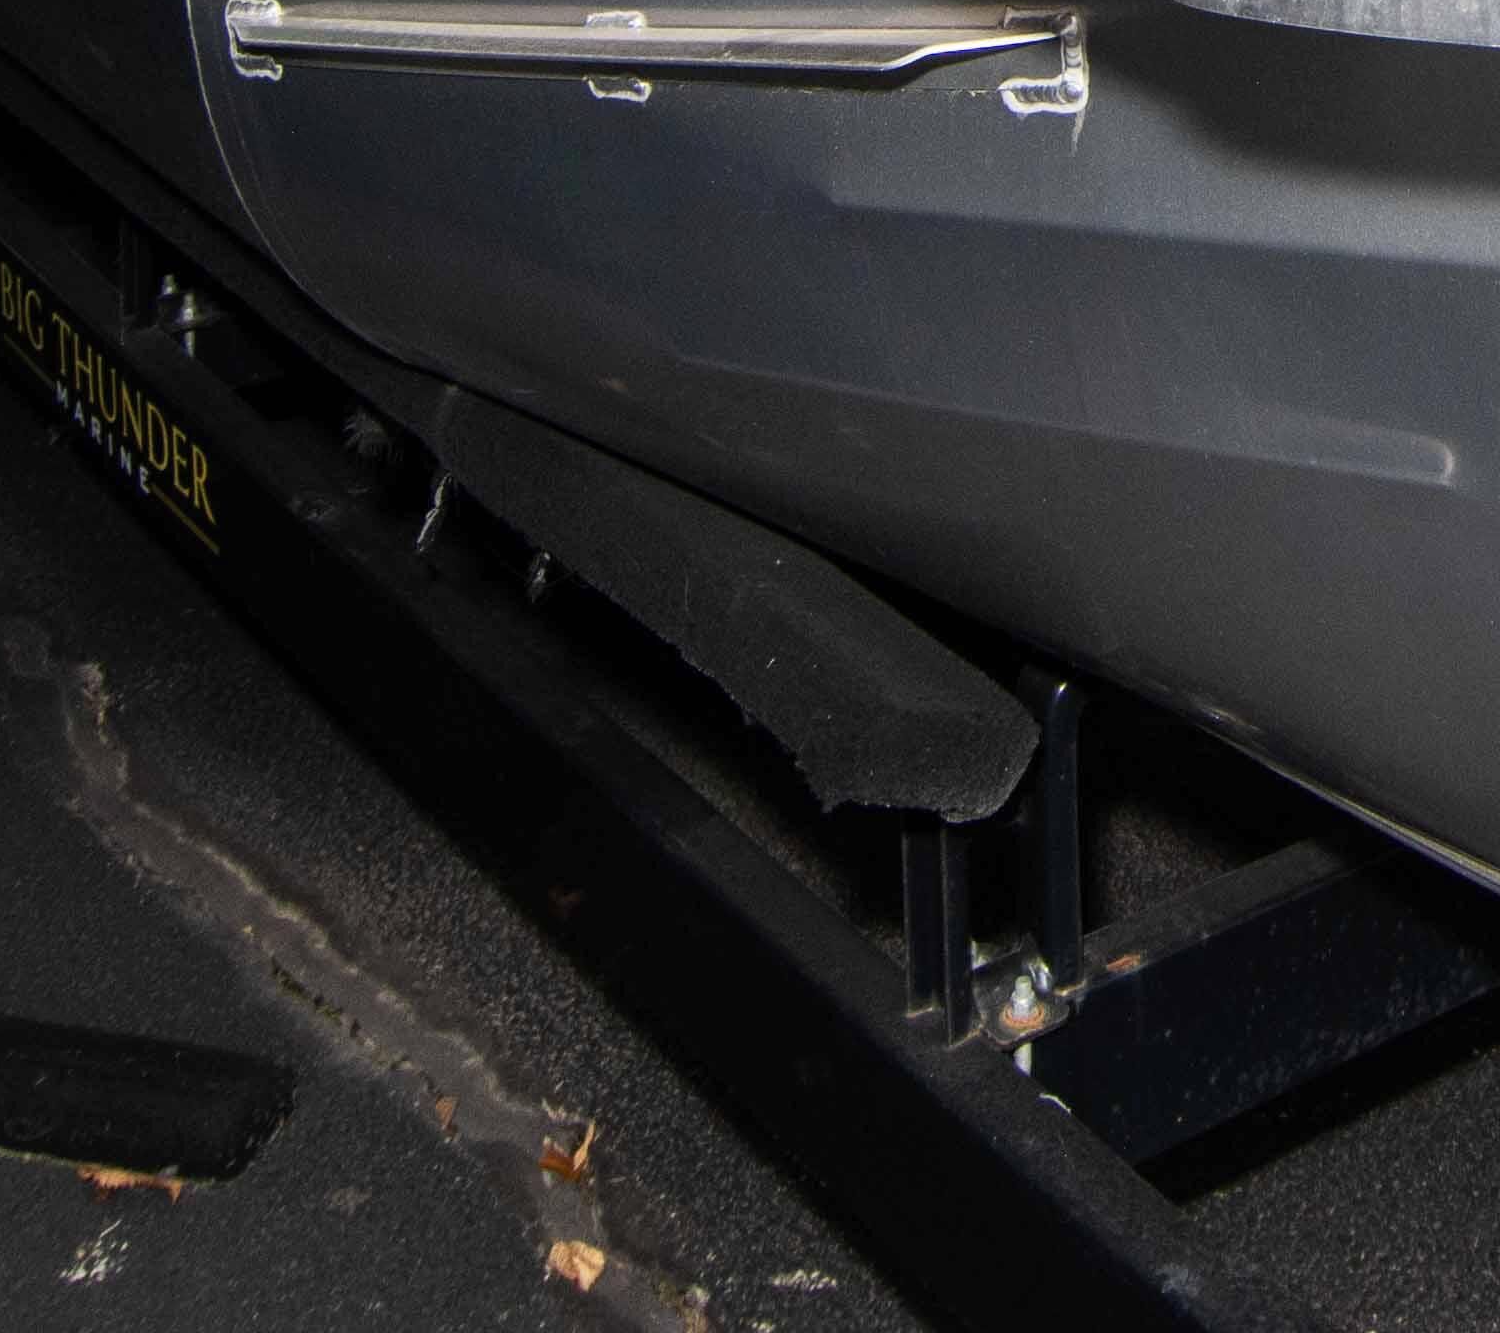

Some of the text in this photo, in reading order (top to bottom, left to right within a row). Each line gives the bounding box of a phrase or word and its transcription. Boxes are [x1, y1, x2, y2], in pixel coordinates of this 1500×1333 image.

[0, 261, 217, 525] BIG THUNDER
[54, 380, 151, 494] MARINE
